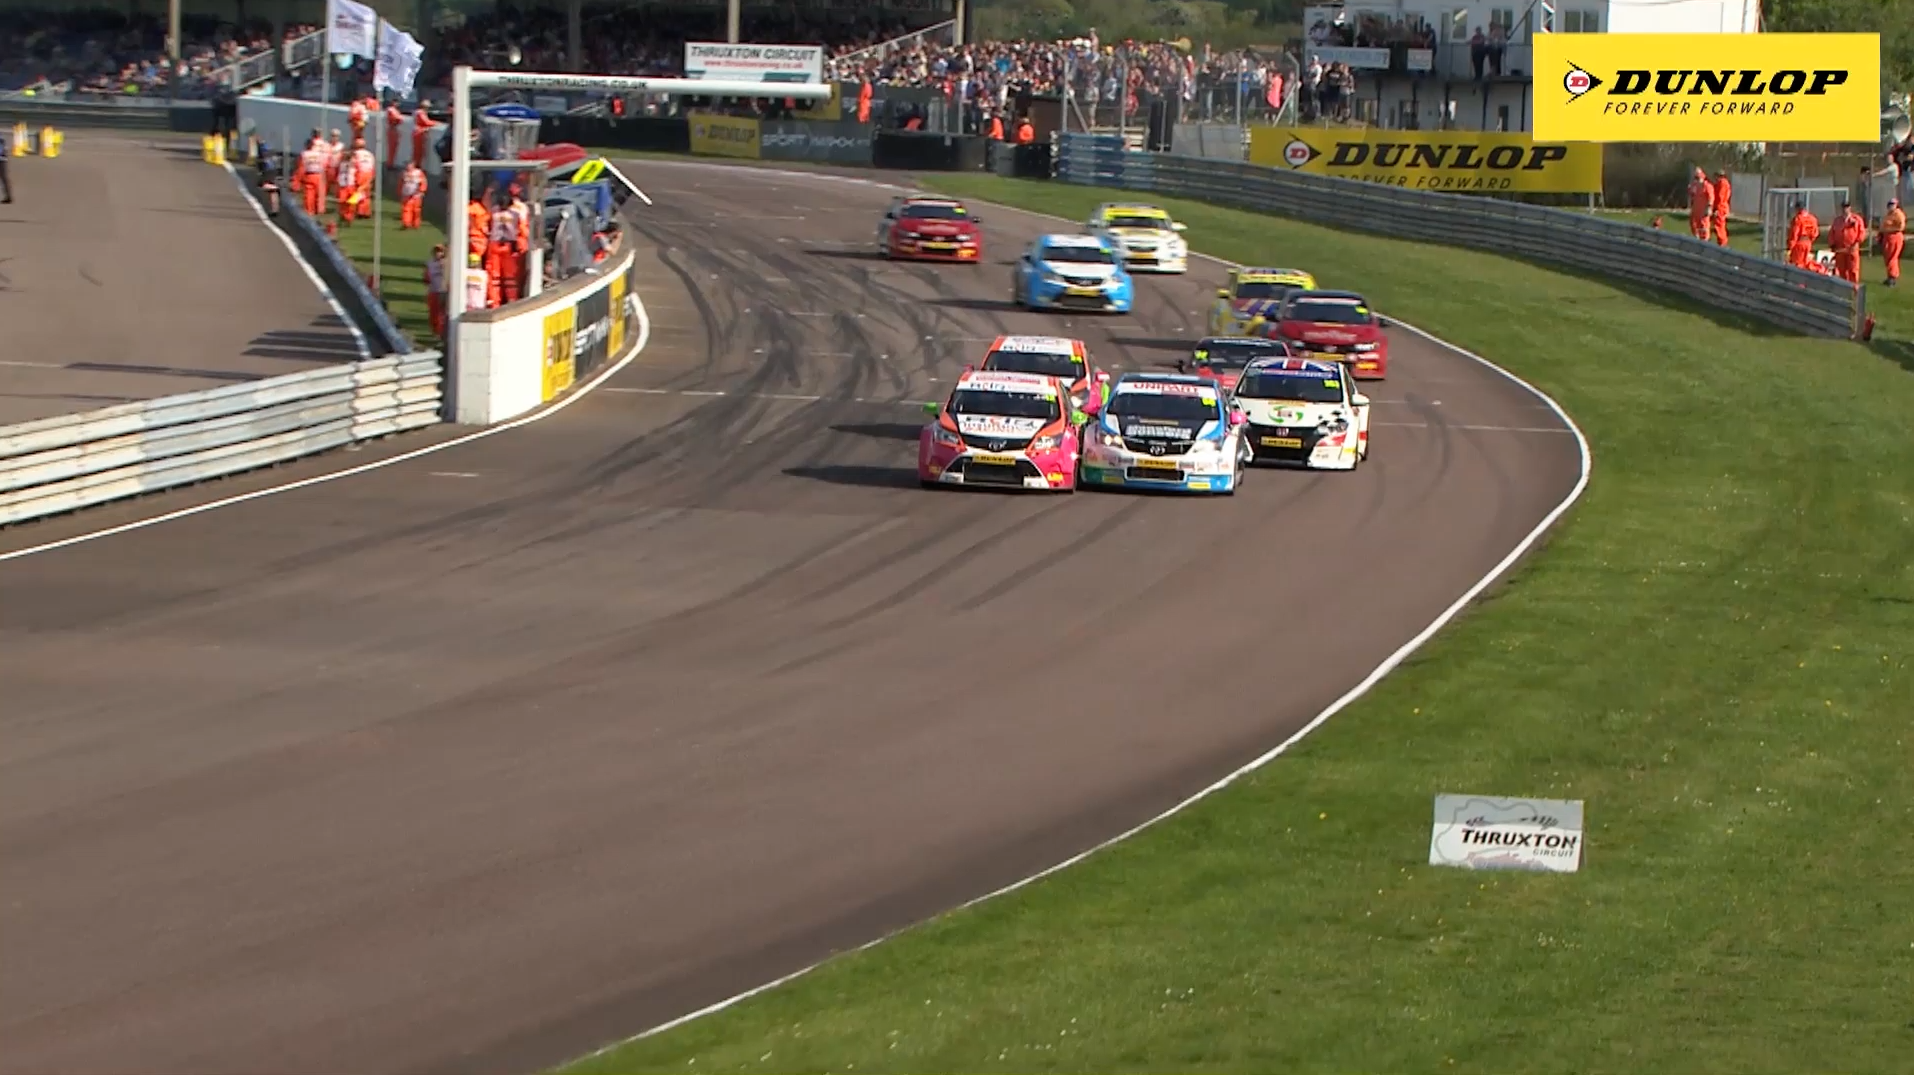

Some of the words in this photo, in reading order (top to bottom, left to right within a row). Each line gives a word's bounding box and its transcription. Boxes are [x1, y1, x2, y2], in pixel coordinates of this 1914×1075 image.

[763, 48, 818, 60] CIRCUIT
[1326, 141, 1568, 170] DUNLOP
[1416, 176, 1511, 189] FORWARD
[1462, 829, 1577, 849] THRUXTON
[1533, 849, 1574, 858] CIRCUIT
